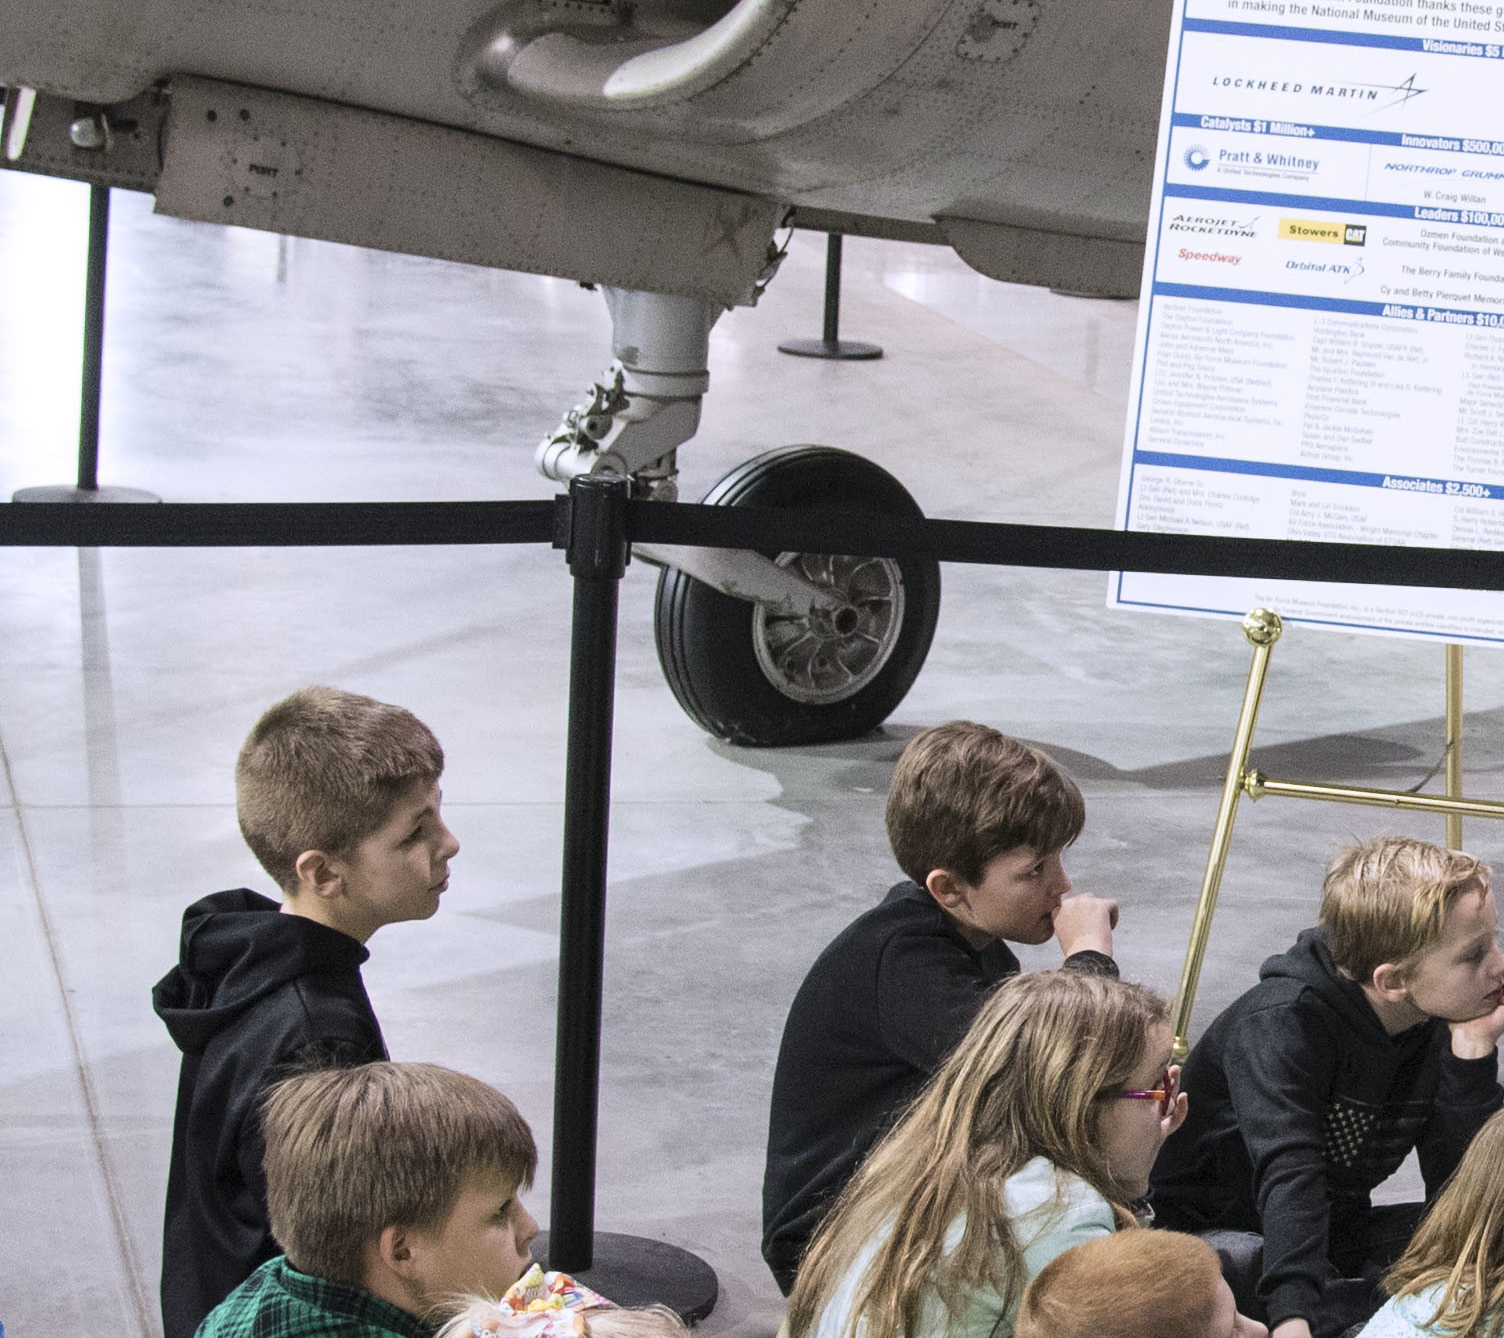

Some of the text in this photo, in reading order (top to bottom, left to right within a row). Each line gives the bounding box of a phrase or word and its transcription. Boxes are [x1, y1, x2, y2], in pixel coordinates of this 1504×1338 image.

[1288, 2, 1308, 15] the
[1310, 4, 1360, 20] National
[1362, 8, 1413, 24] Museum
[1415, 13, 1428, 26] of
[1430, 14, 1450, 28] the
[1452, 17, 1491, 31] United
[1459, 1, 1493, 15] these
[1421, 39, 1483, 56] Visionaries
[1484, 45, 1499, 58] $5
[1212, 75, 1378, 100] LOCKHEED MARTIN
[1199, 115, 1252, 133] Catalysts
[1252, 120, 1267, 134] $1
[1400, 134, 1460, 152] Innovators
[1218, 148, 1319, 172] Pratt & Whitney
[1383, 161, 1457, 176] NORTHROP
[1434, 190, 1458, 203] Craig
[1172, 213, 1236, 228] AEROJET
[1413, 206, 1459, 222] Leaders
[1168, 222, 1255, 237] ROCKETDYNE
[1288, 224, 1339, 238] Stowers
[1450, 231, 1499, 245] Foundation
[1381, 236, 1431, 251] Community
[1431, 241, 1480, 255] Foundation
[1481, 246, 1491, 256] of
[1177, 247, 1242, 266] Speedway
[1285, 260, 1350, 274] Orbital ATK
[1400, 264, 1417, 275] The
[1417, 265, 1442, 279] Berry
[1442, 268, 1472, 281] Family
[1392, 286, 1410, 296] and
[1410, 287, 1434, 300] Betty
[1382, 304, 1414, 319] Allies
[1414, 307, 1425, 320] &
[1426, 308, 1475, 325] Partners
[1382, 476, 1491, 499] Associates $2,500+
